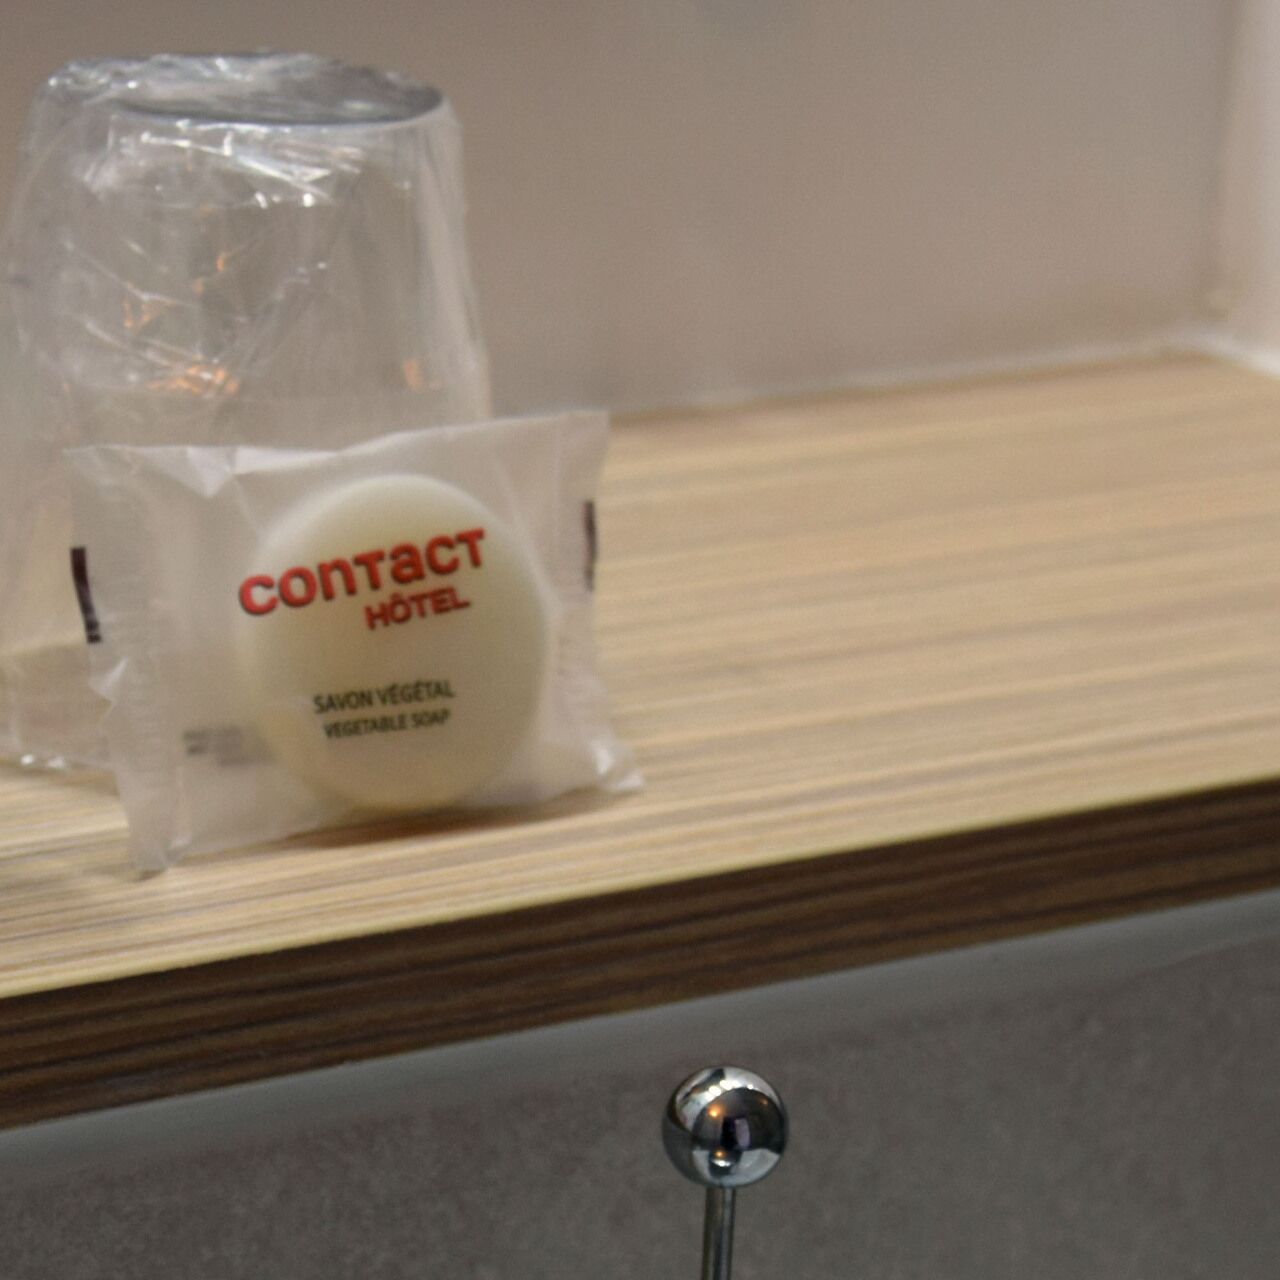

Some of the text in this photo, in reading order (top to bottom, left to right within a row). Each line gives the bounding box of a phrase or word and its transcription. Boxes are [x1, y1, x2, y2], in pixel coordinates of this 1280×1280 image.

[364, 586, 472, 631] HÔTEL
[313, 679, 456, 716] SAVON VÉGÉTAL
[324, 708, 451, 740] VEGETABLE SOAP
